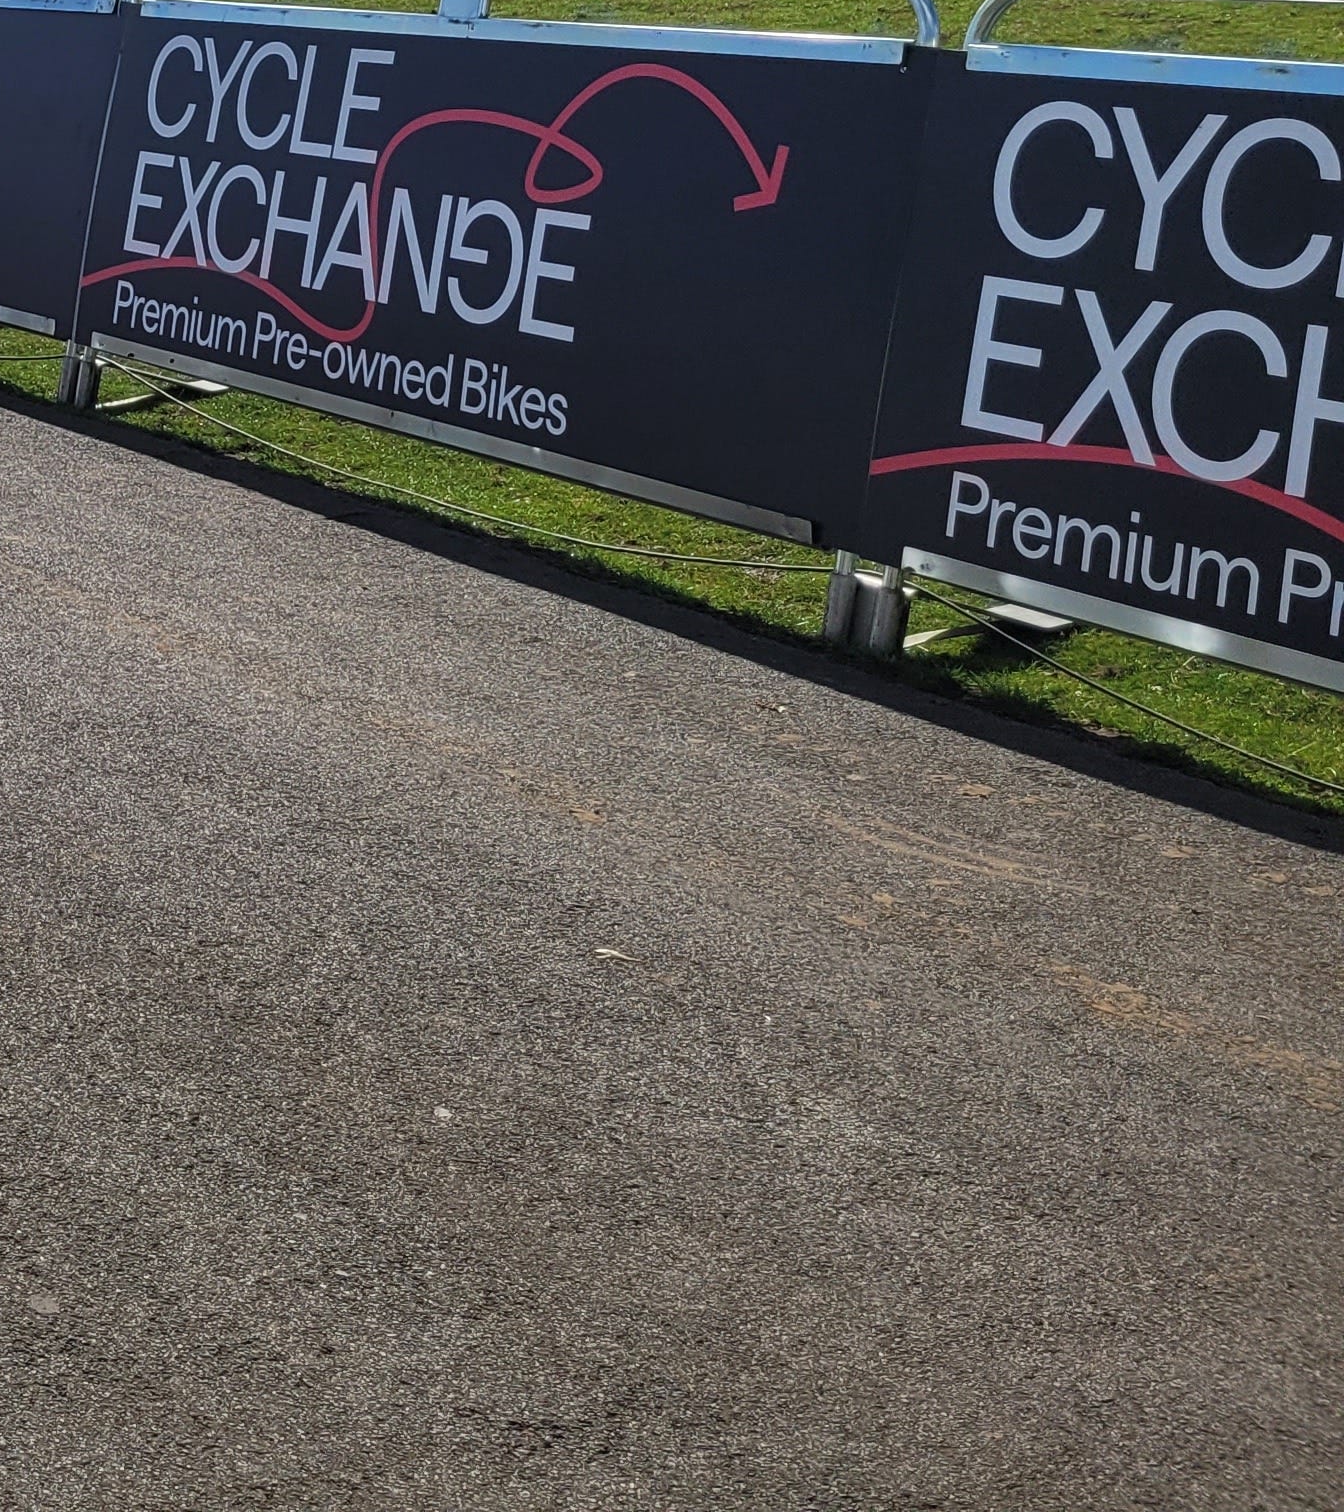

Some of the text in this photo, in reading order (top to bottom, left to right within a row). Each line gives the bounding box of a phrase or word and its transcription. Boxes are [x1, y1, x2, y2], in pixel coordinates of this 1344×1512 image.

[147, 34, 395, 165] CYCLE
[123, 150, 592, 343] EXCHANGE
[993, 100, 1344, 299] CYC
[112, 280, 568, 437] Premium Pre-owned Bikes
[946, 471, 1260, 616] Premium
